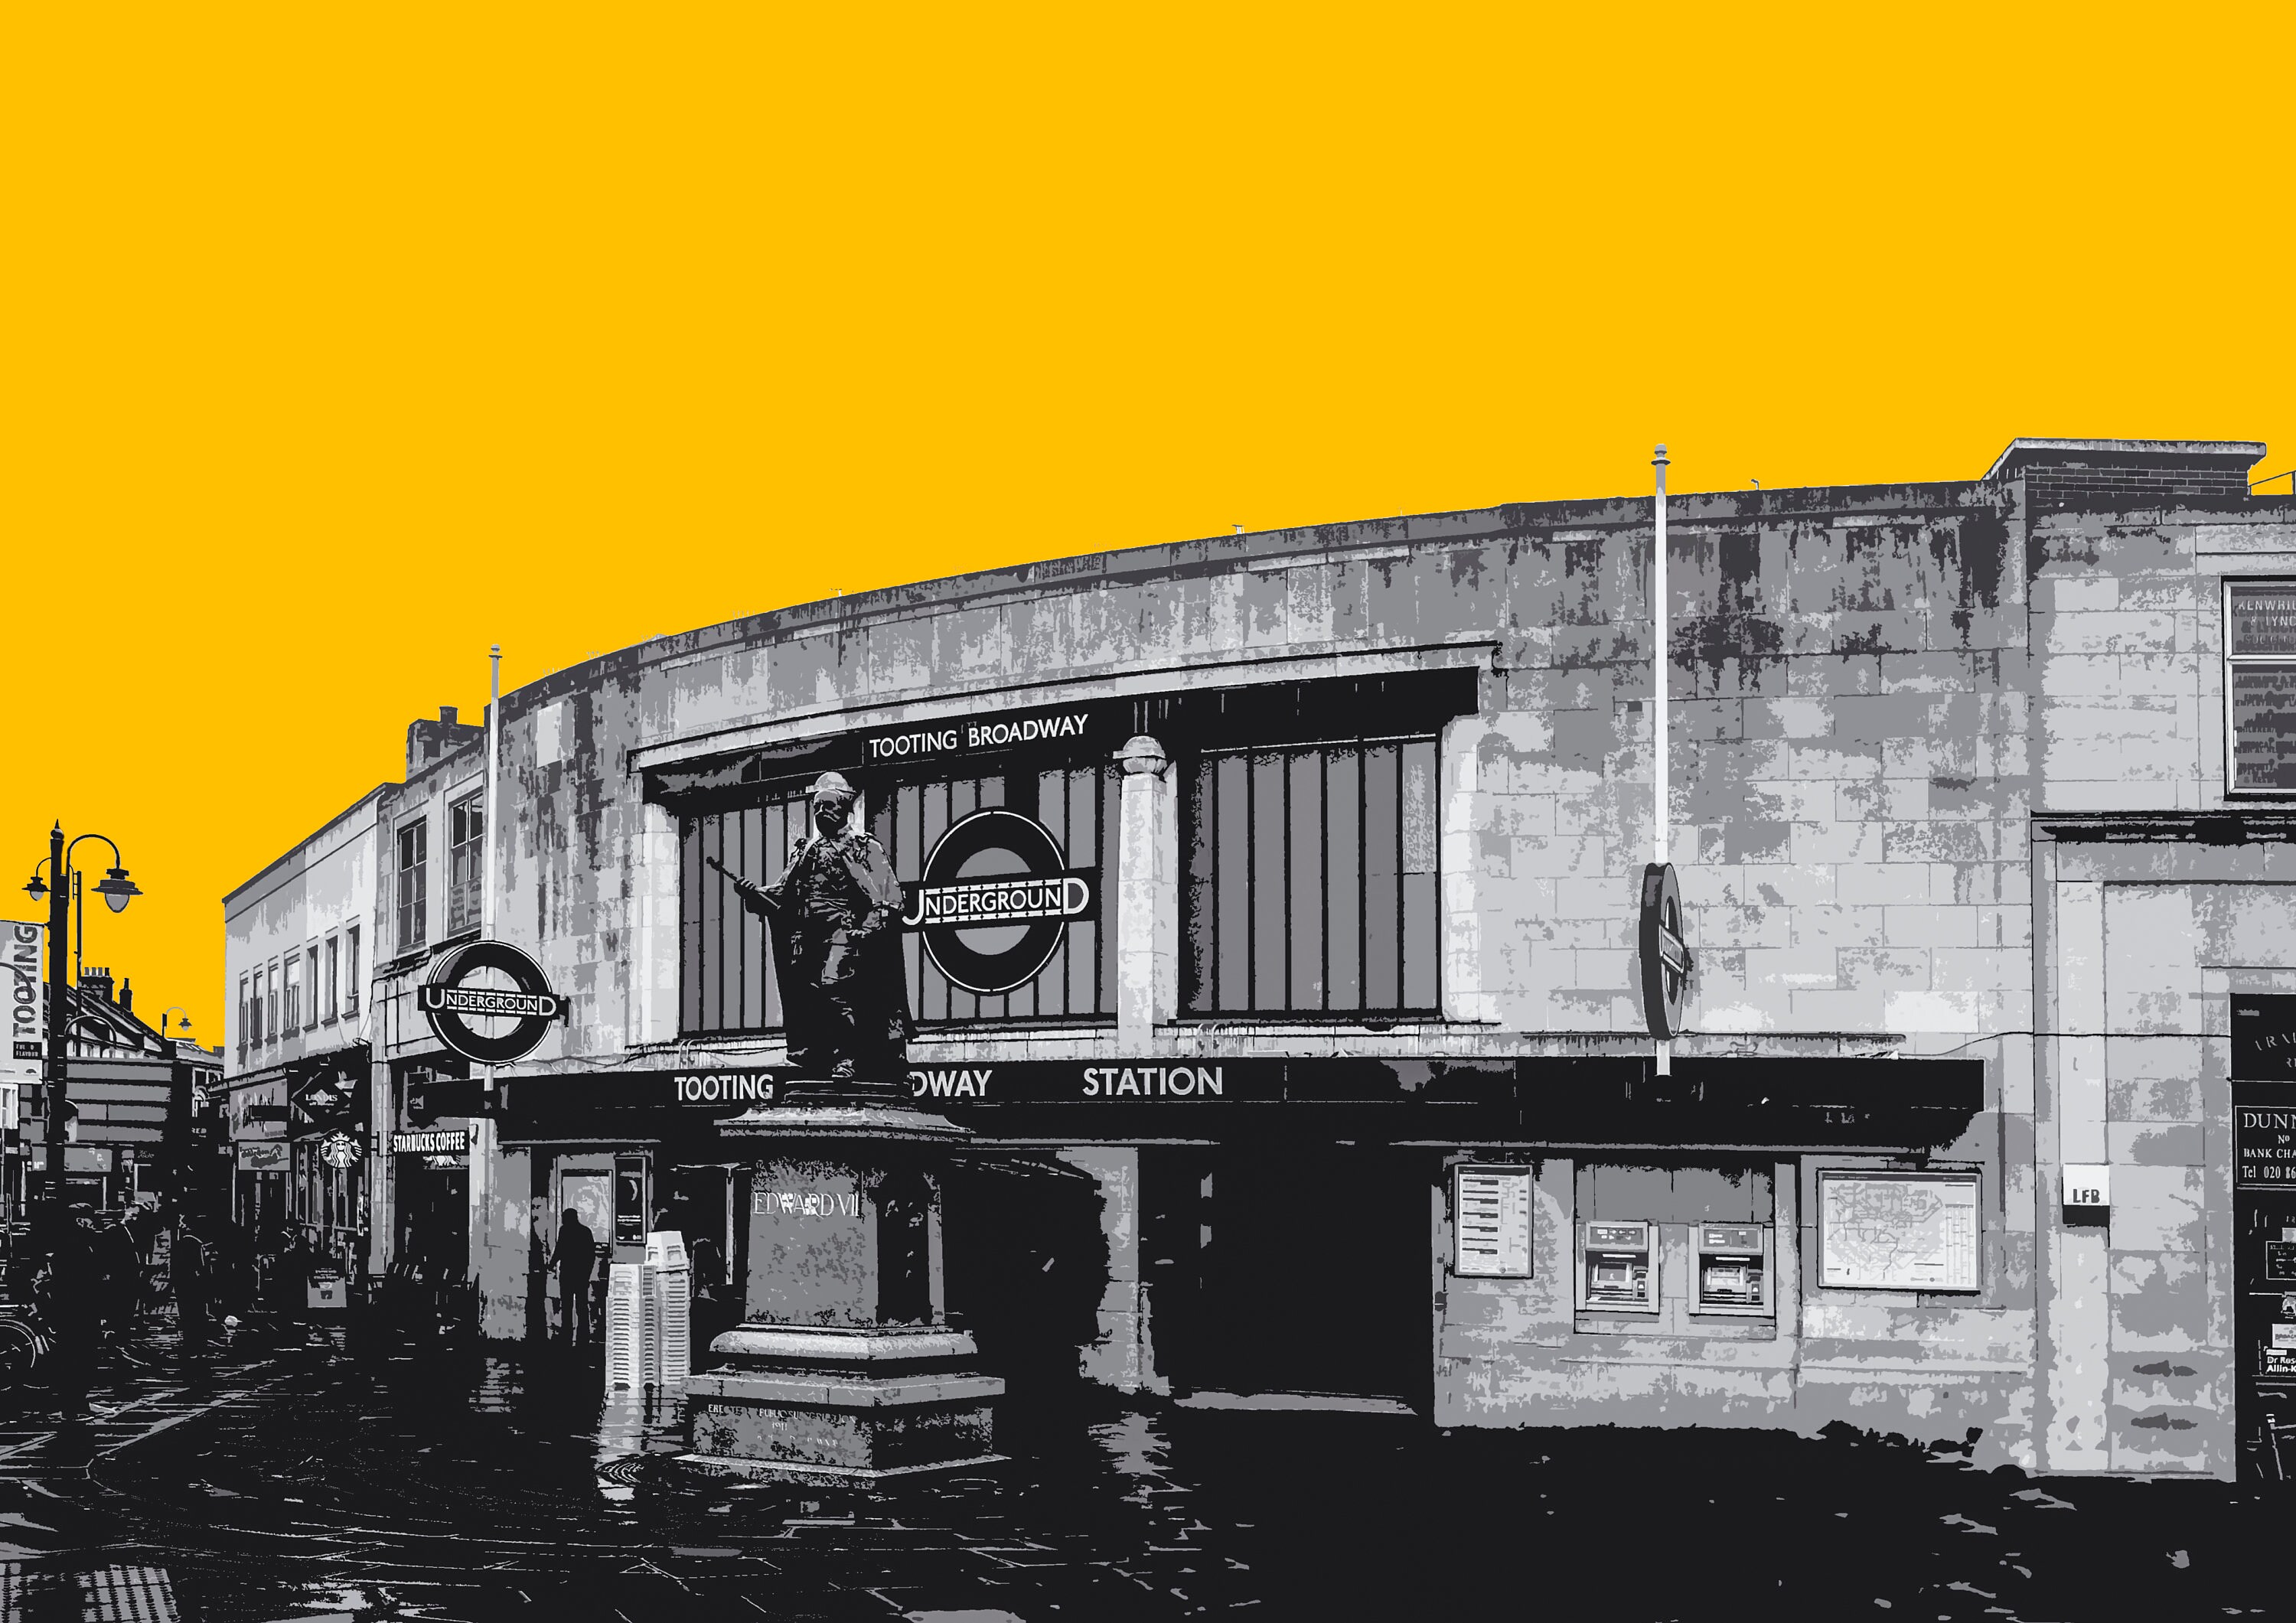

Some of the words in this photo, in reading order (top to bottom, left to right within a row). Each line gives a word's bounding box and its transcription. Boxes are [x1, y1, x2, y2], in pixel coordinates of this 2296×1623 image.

[869, 730, 957, 758] TOOTING
[968, 714, 1088, 748] BROADWAY
[13, 925, 38, 1038] TOOTING
[426, 987, 557, 1016] UNDERGROUND
[674, 1074, 774, 1100] TOOTING
[911, 1070, 993, 1096] DWAY
[1082, 1067, 1223, 1097] STATION
[393, 1133, 435, 1152] STARBUCKS
[435, 1132, 465, 1151] COFFEE
[2244, 1149, 2272, 1158] BANK
[2242, 1165, 2256, 1178] Tel
[2264, 1166, 2281, 1178] 020
[753, 1191, 834, 1220] EDWARD
[2073, 1188, 2100, 1204] LFB
